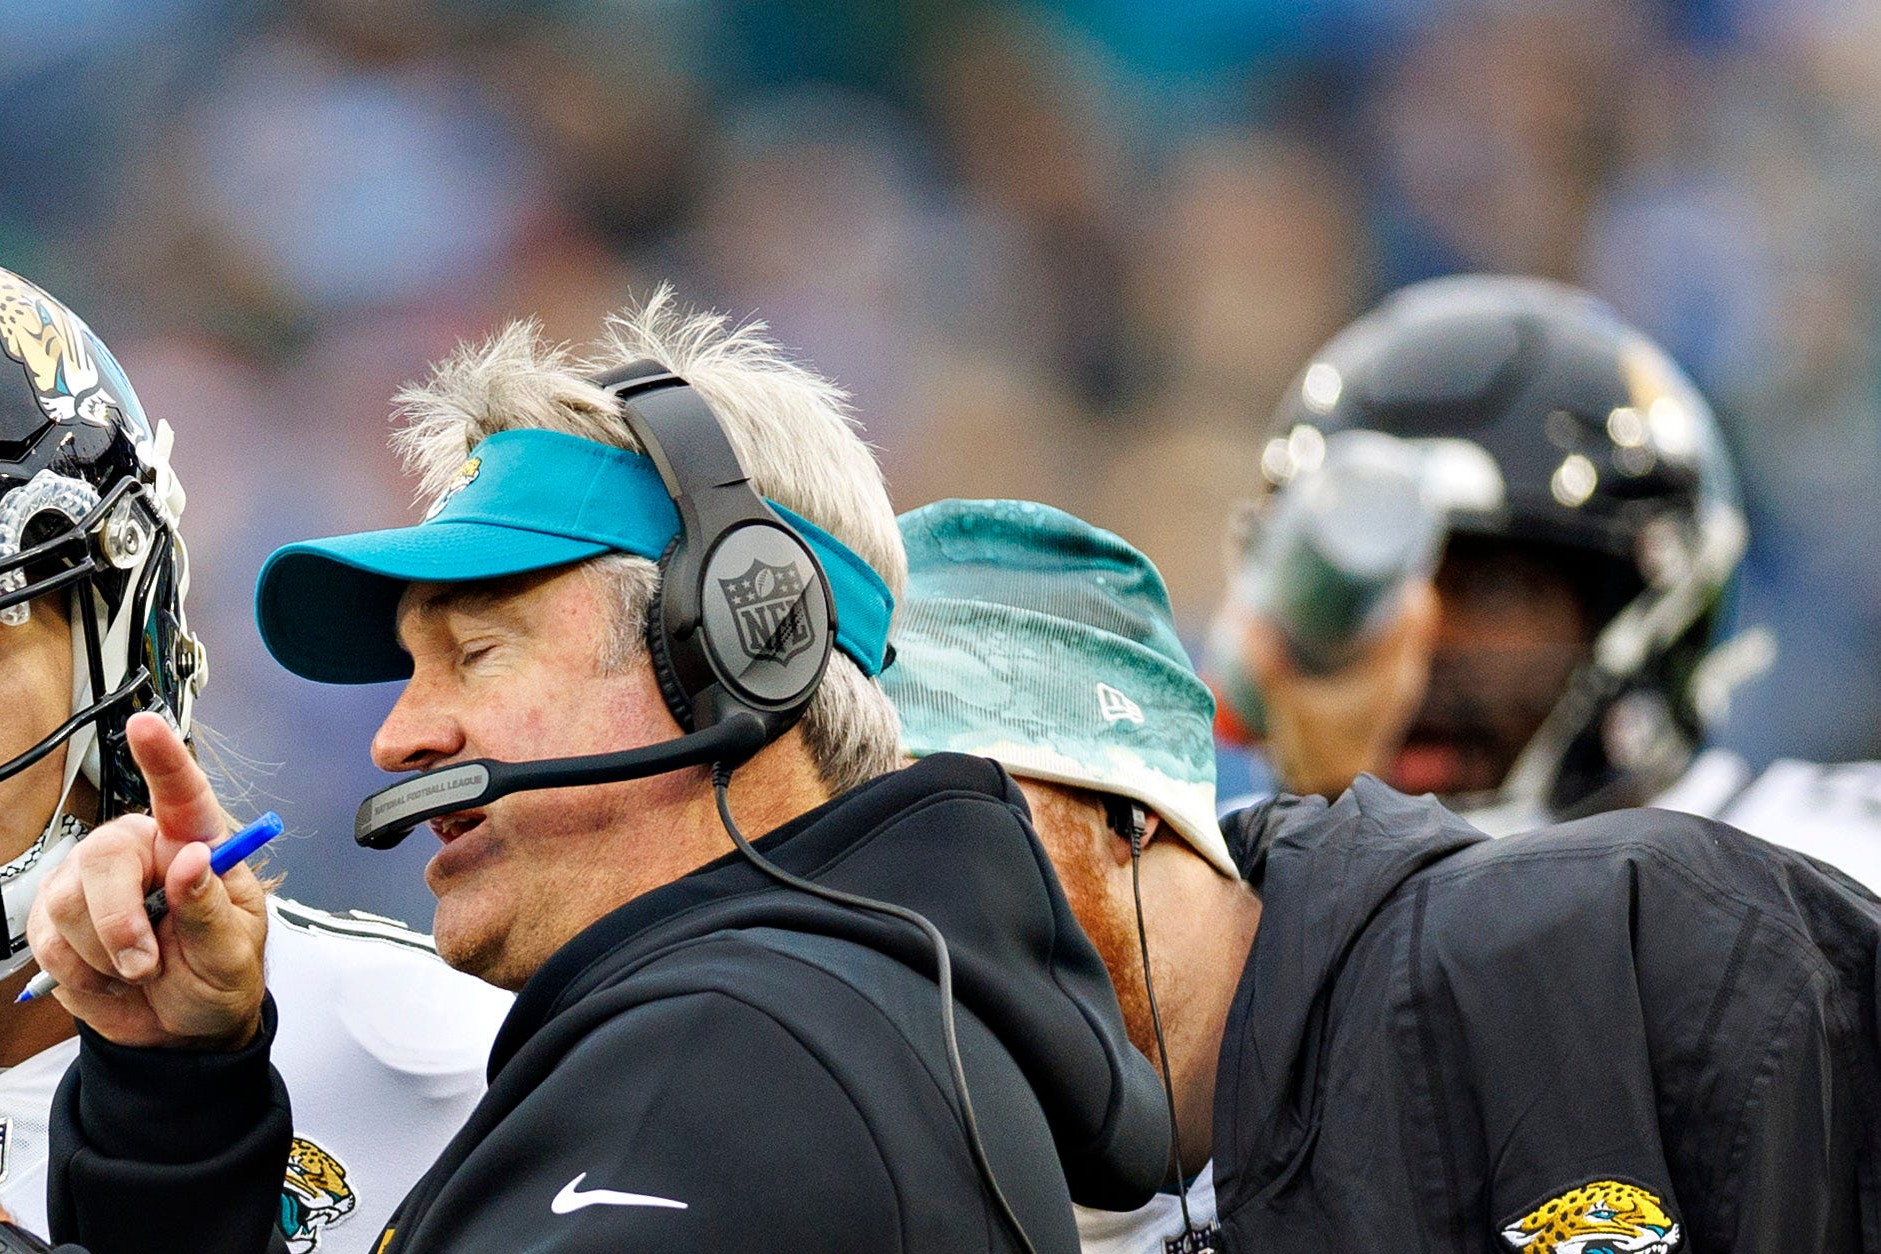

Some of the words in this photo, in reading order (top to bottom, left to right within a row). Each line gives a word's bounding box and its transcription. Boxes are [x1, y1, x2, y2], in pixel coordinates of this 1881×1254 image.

[740, 601, 809, 652] NFL
[374, 796, 405, 816] NATIONAL
[406, 782, 446, 802] FOOTBALL
[446, 774, 483, 791] LEAGUE
